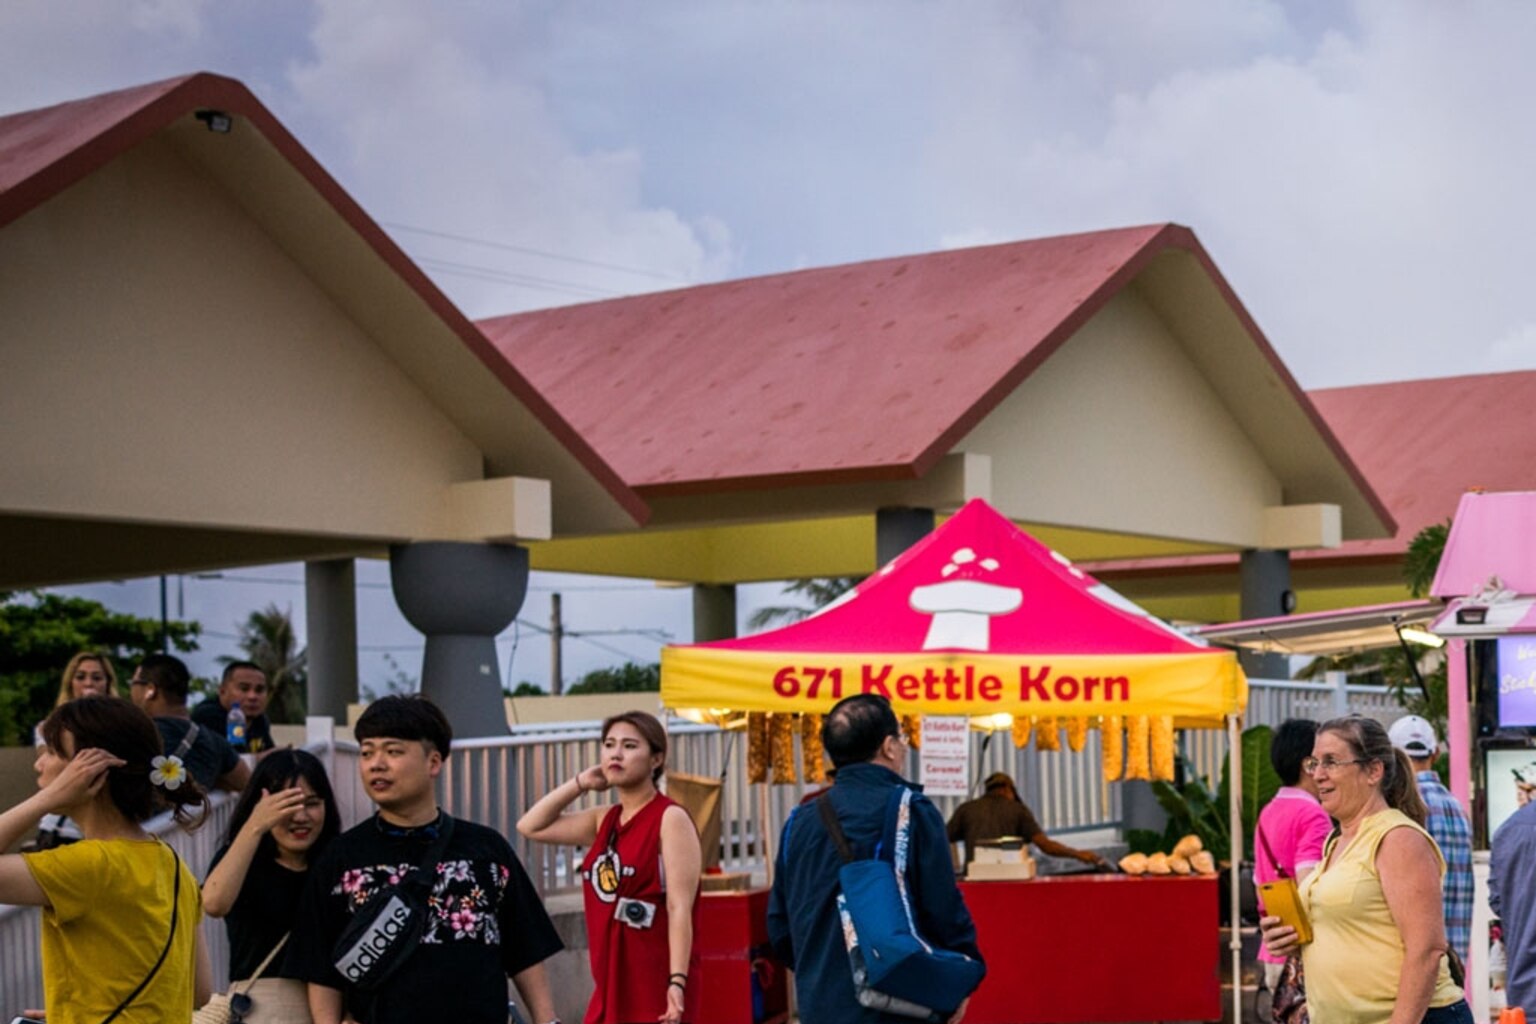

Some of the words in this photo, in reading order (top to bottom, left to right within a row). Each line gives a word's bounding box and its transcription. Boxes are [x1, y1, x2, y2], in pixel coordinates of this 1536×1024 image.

[773, 666, 843, 699] 671
[861, 664, 1003, 701] Kettle
[1019, 665, 1130, 702] Korn
[926, 763, 963, 775] Caramel
[346, 906, 406, 980] adidas
